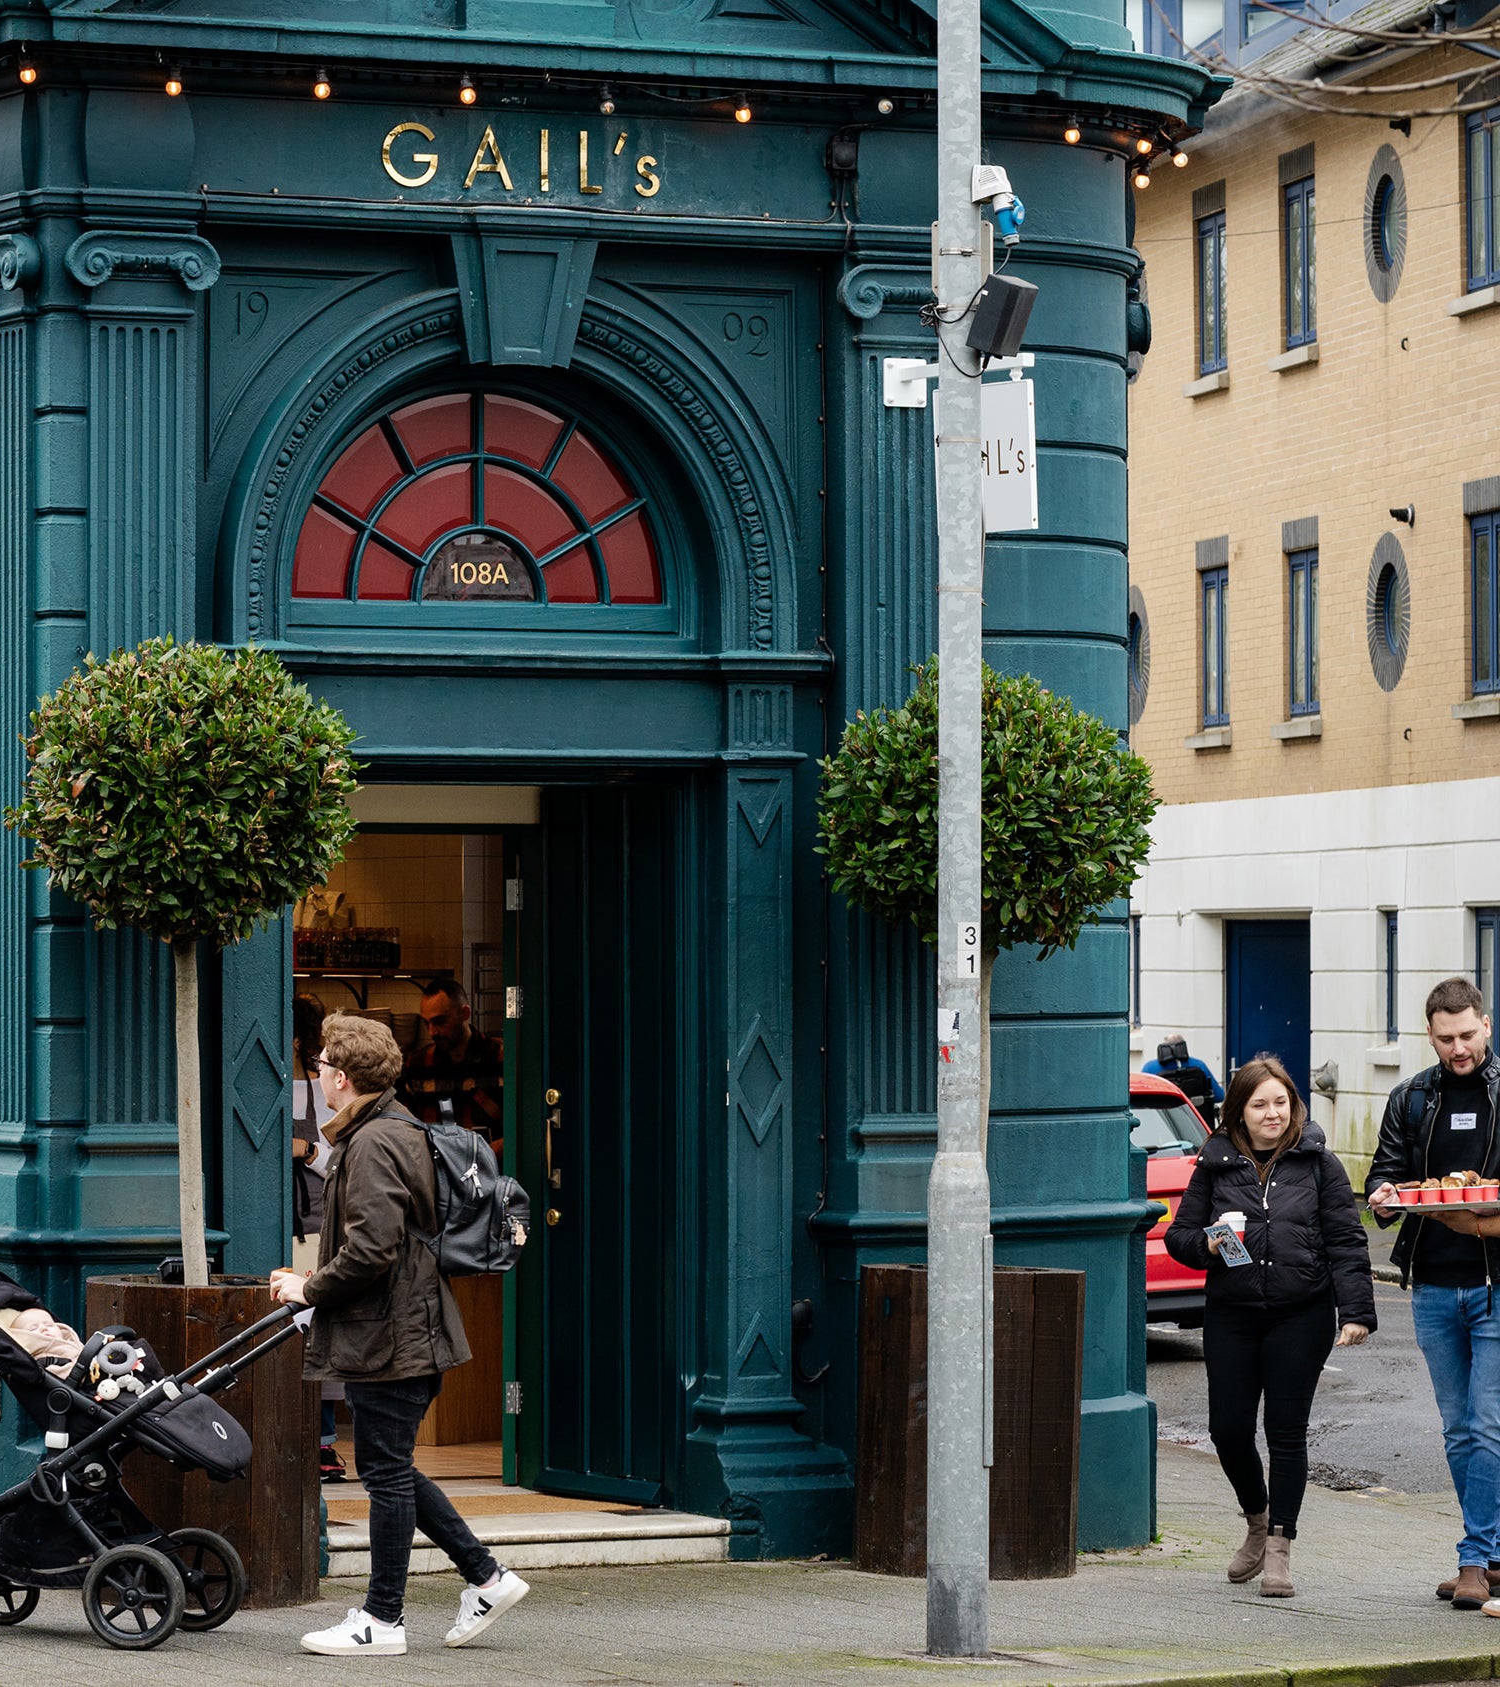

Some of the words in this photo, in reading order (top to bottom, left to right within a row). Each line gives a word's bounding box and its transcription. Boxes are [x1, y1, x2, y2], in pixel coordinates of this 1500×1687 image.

[382, 122, 660, 197] GAIL's
[231, 291, 269, 345] 19
[450, 562, 510, 585] 108A
[964, 926, 977, 946] 3
[966, 954, 975, 974] 1
